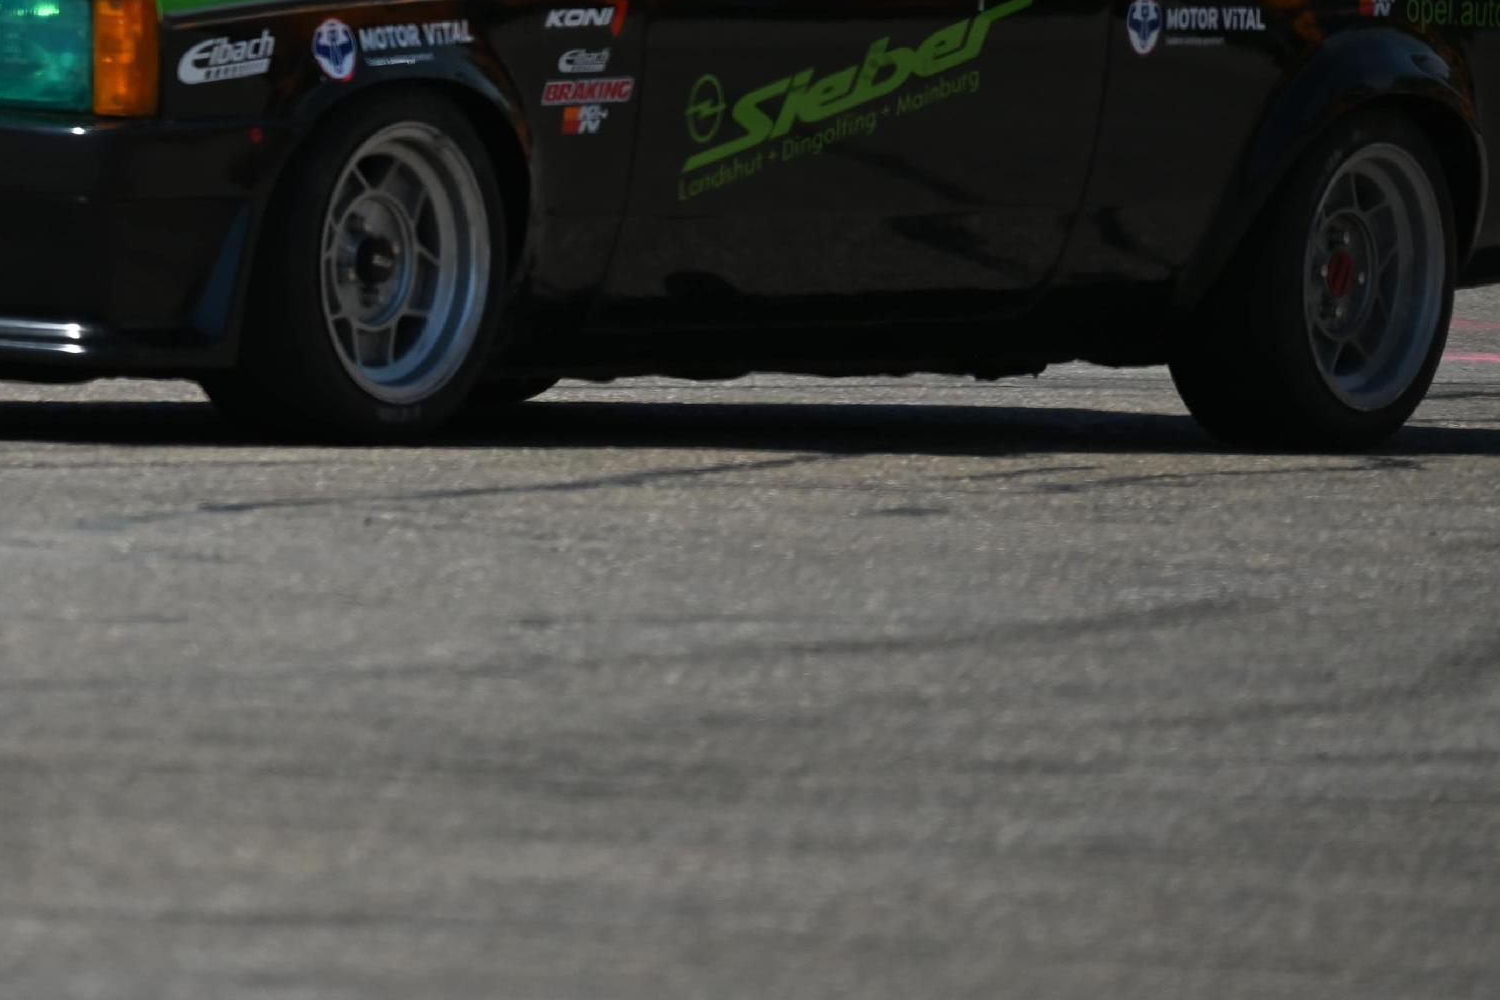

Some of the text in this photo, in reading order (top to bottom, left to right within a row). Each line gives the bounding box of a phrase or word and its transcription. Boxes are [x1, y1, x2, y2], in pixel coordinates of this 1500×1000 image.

[545, 6, 615, 28] KONI
[1166, 8, 1219, 31] MOTOR
[358, 22, 422, 52] MOTOR
[177, 27, 276, 84] Eibach
[544, 79, 631, 102] BRAKING
[678, 152, 763, 201] Landshut
[781, 109, 877, 162] Dingolfing
[896, 69, 981, 116] Mainburg
